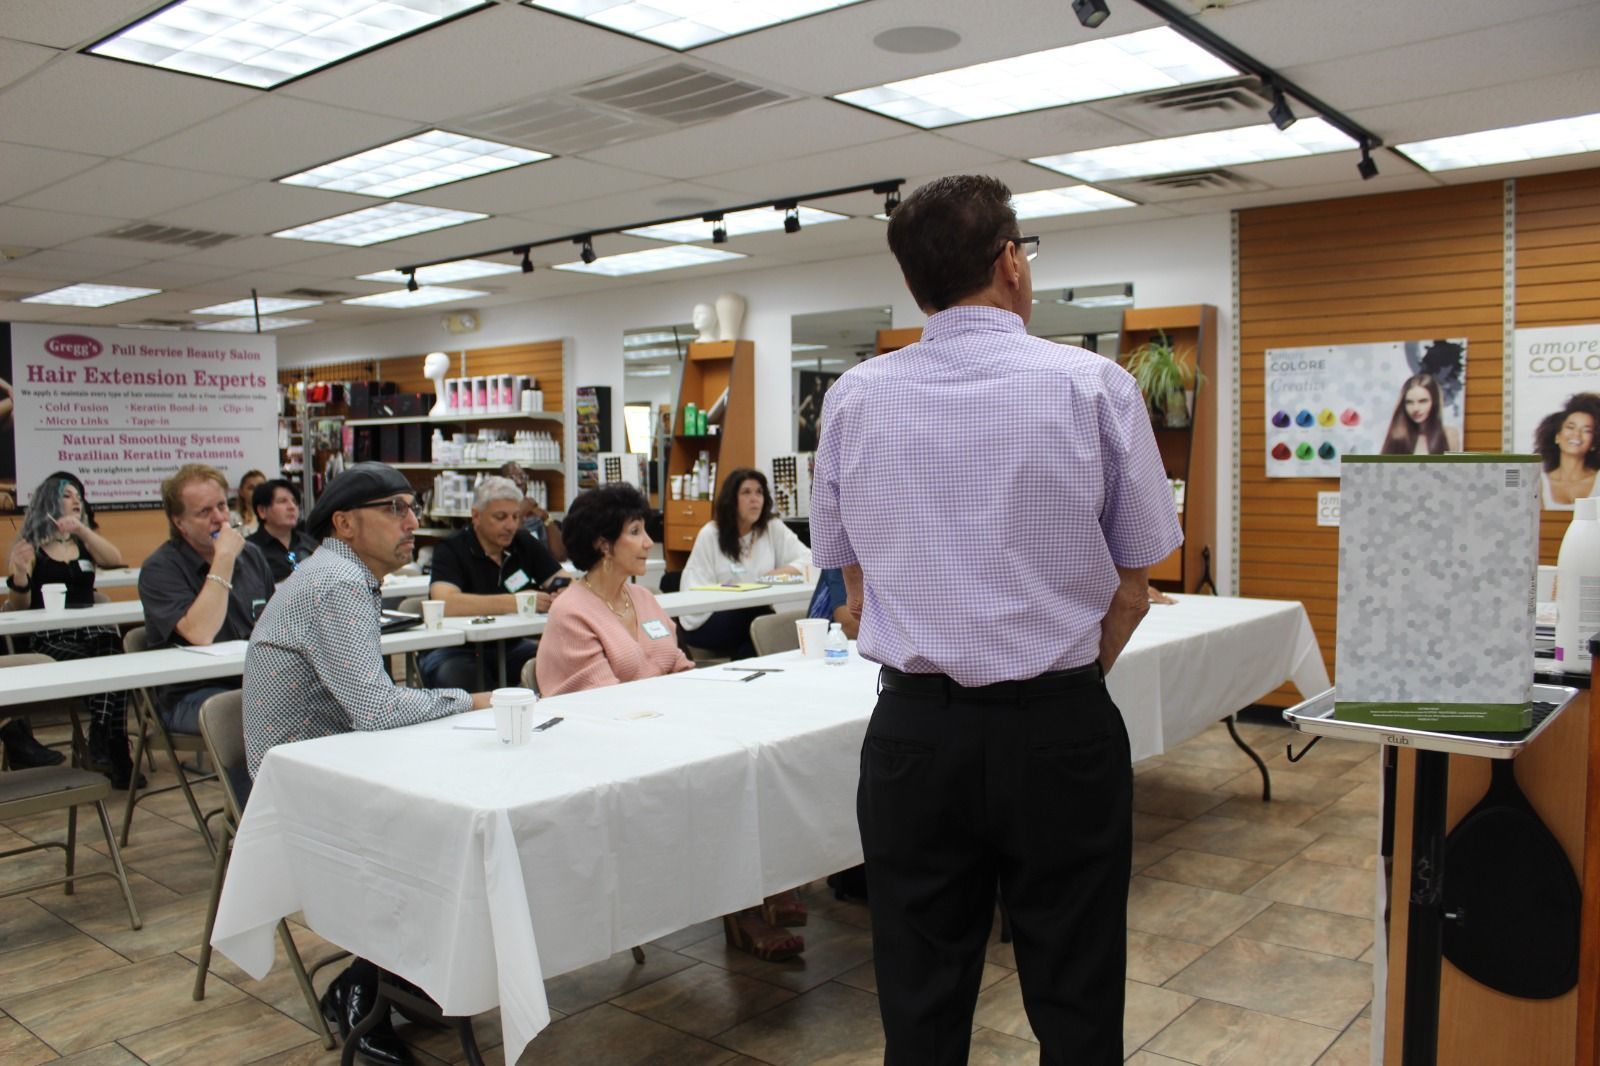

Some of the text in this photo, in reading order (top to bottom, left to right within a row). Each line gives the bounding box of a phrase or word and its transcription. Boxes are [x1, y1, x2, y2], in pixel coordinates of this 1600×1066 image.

[49, 339, 98, 357] Gregg's
[112, 344, 261, 361] Full Service Beauty Salon
[1528, 340, 1599, 356] amore
[1271, 360, 1326, 372] COLORE
[26, 364, 266, 391] Hair Extension Experts
[33, 390, 51, 398] apply
[108, 390, 121, 398] type
[132, 390, 142, 398] hair
[46, 402, 108, 412] Cold Fusion
[130, 403, 208, 413] Keratin Bond-in
[224, 404, 254, 414] Clip-in
[46, 416, 109, 426] Micro Links
[132, 417, 169, 427] Tape-in
[63, 434, 240, 446] Natural Smoothing Systems
[58, 450, 244, 461] Brazilian Keratin Treatments
[93, 466, 132, 475] straighten
[152, 464, 179, 472] smooth
[1387, 736, 1408, 745] club
